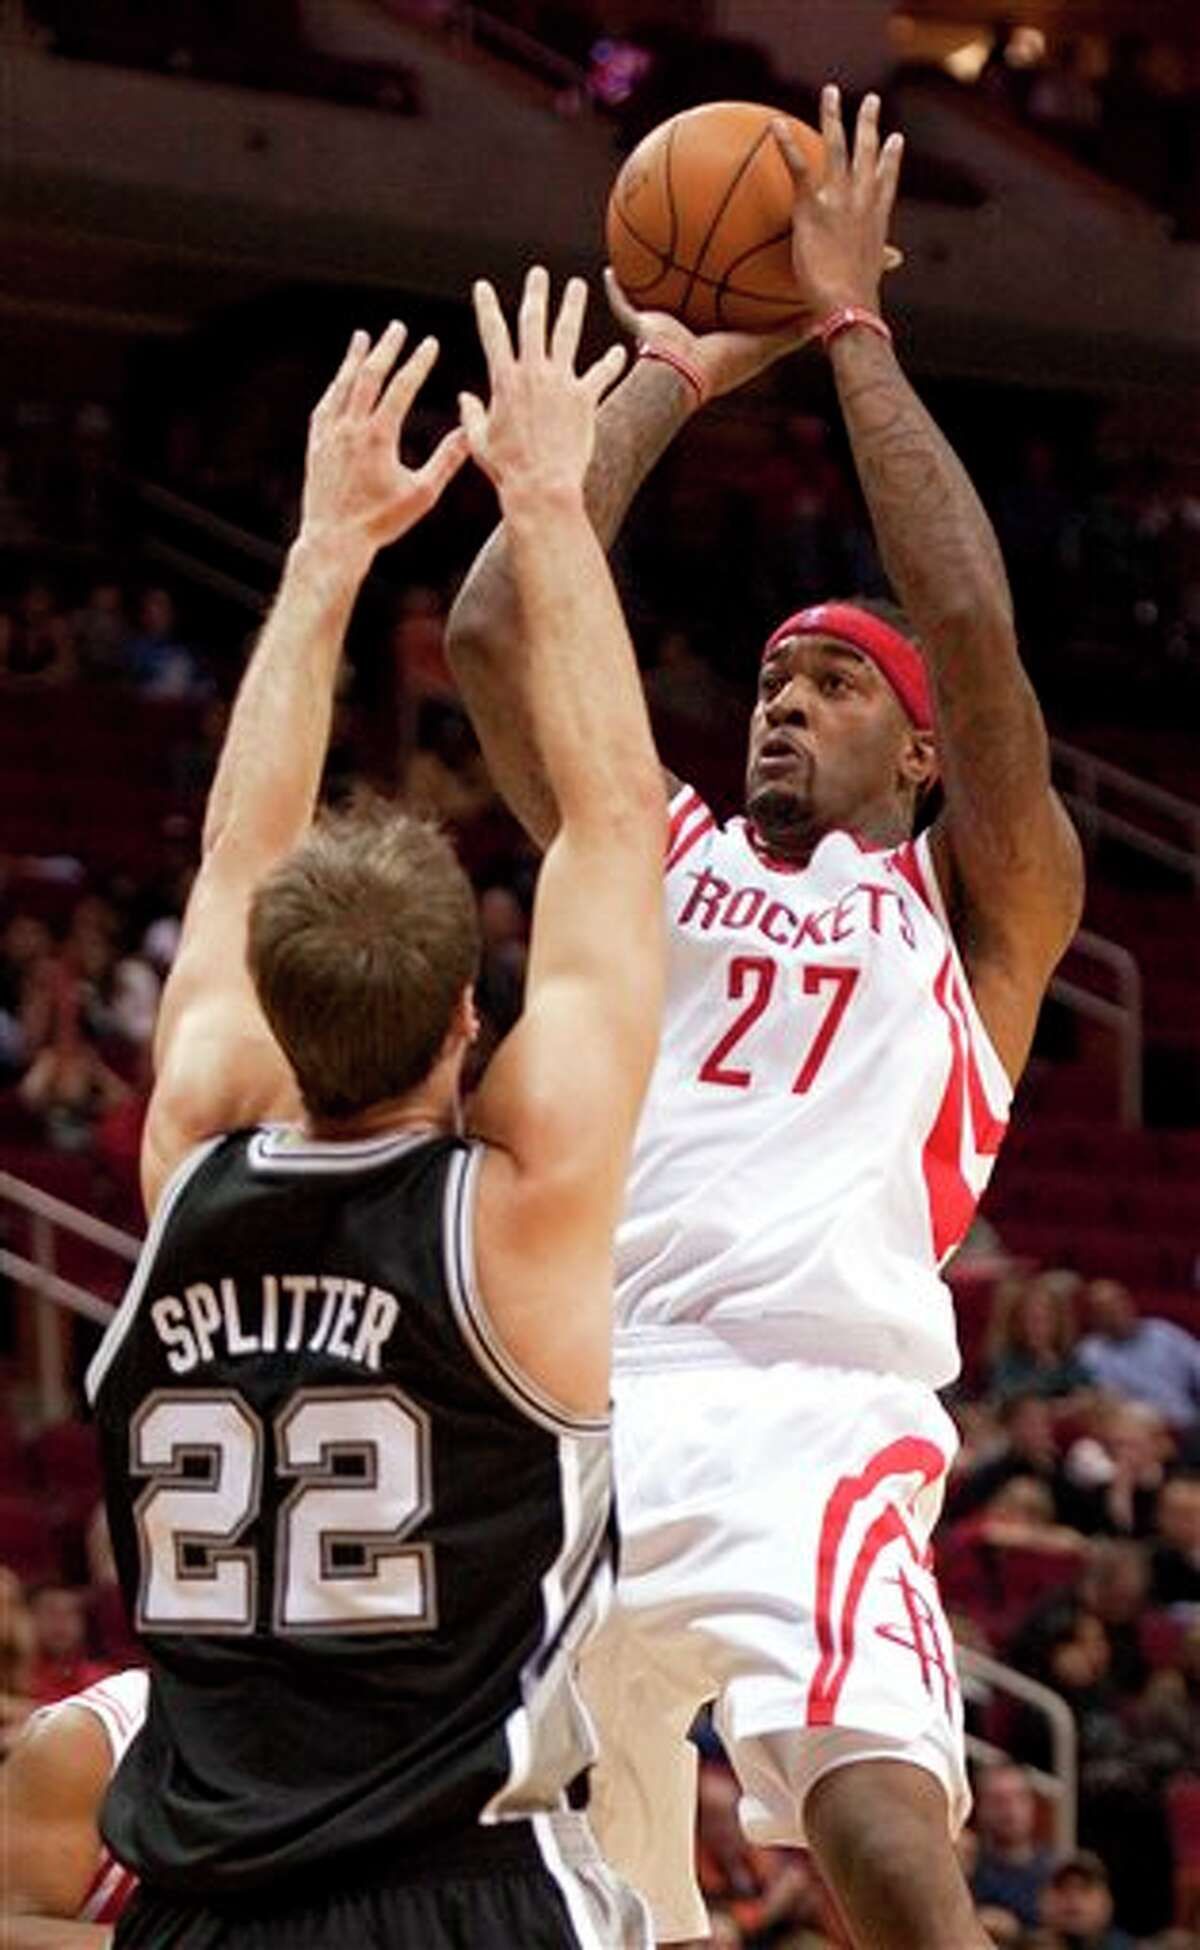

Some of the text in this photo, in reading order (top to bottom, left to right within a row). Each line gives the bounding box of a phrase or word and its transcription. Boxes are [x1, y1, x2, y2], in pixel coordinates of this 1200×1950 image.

[677, 866, 916, 949] ROCKETS
[698, 956, 860, 1094] 27
[151, 1274, 399, 1373] SPLITTER
[129, 1386, 437, 1635] 22
